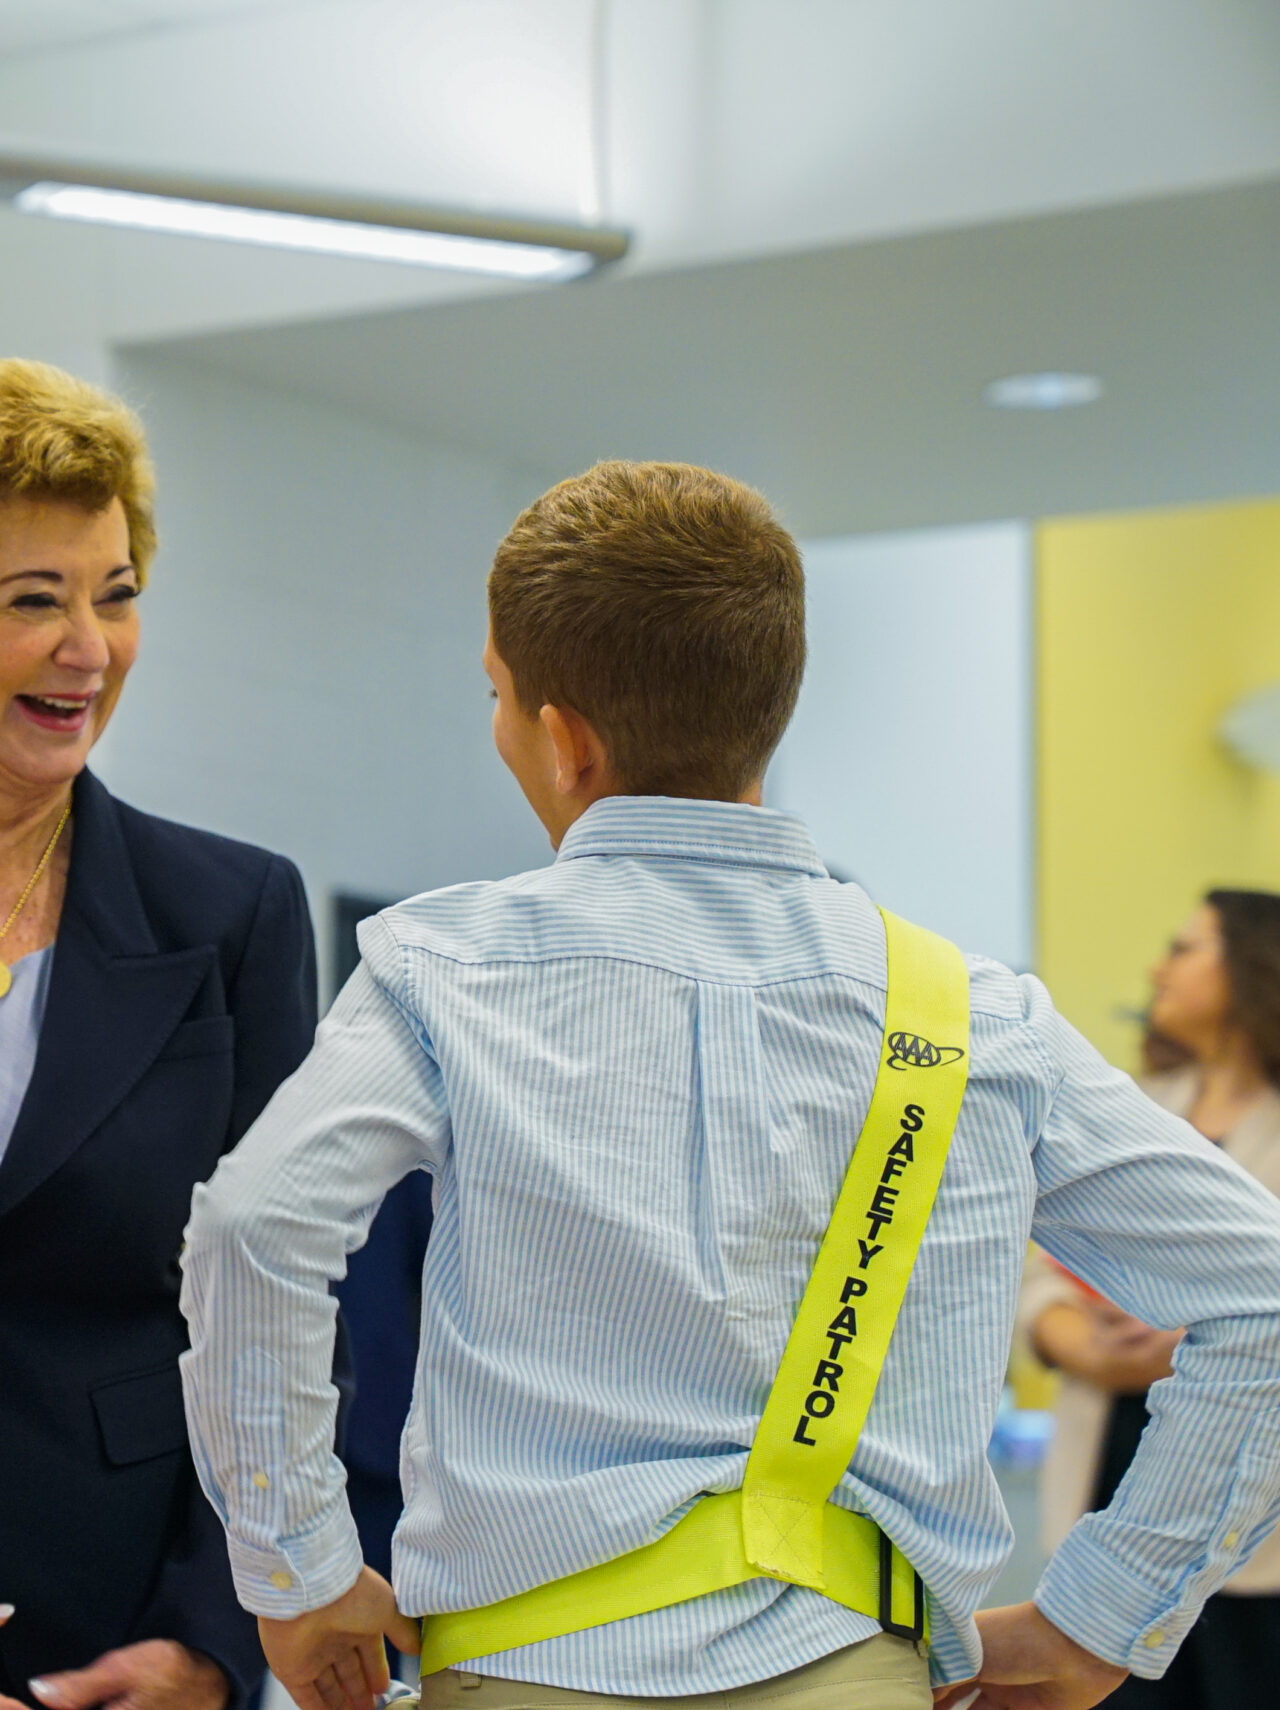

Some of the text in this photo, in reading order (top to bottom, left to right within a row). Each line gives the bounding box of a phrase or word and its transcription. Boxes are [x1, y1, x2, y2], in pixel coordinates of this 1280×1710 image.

[894, 1033, 935, 1066] AAA
[792, 1103, 926, 1447] SAFETY PATROL
